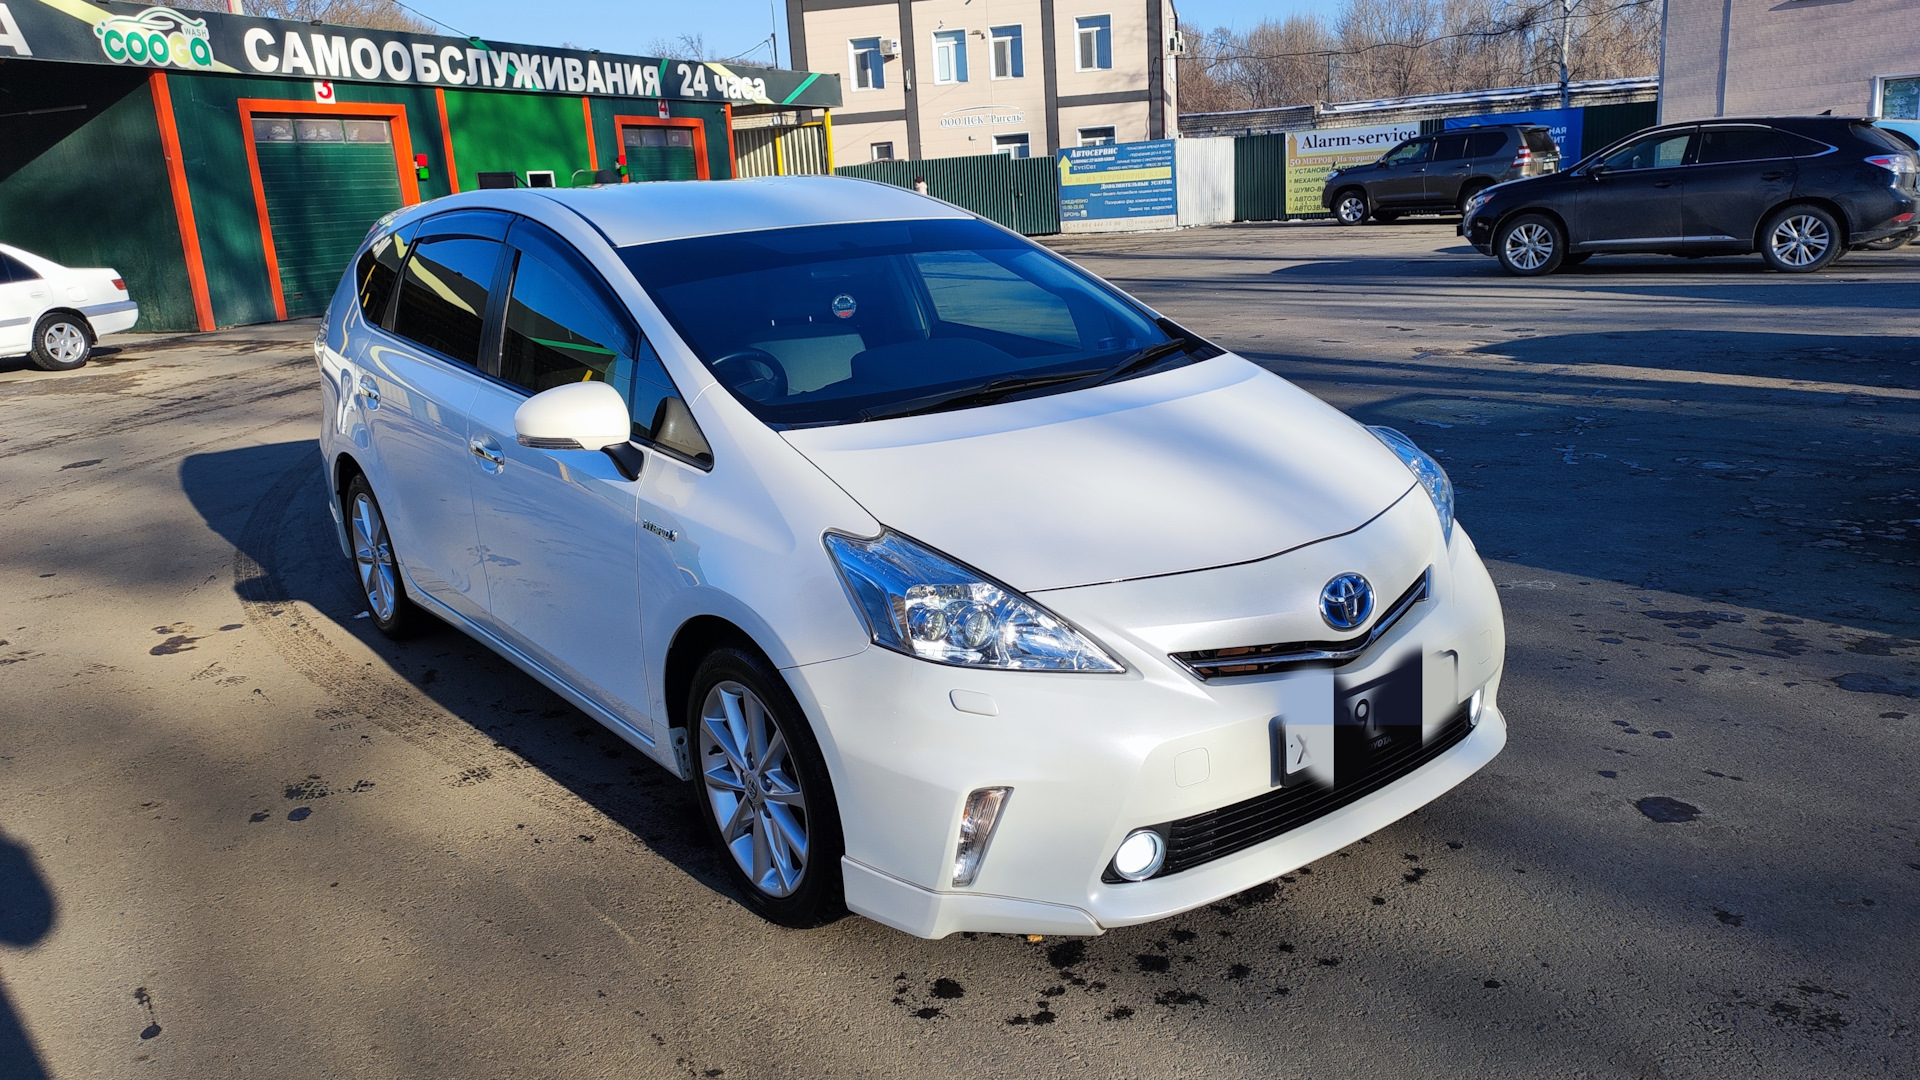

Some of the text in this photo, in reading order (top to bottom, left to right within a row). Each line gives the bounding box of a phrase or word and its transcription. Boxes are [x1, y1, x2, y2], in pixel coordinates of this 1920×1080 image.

[184, 27, 207, 37] WASH
[243, 27, 767, 100] САМООБСЛУЖИВАНИЯ 24 часа
[317, 79, 333, 99] 3
[658, 98, 668, 115] 4
[940, 117, 961, 127] ООО
[963, 115, 984, 126] ПСК
[1548, 126, 1567, 135] НАЯ
[1301, 128, 1417, 149] Alarm-service
[1289, 158, 1301, 167] 50
[1302, 156, 1333, 165] МЕТРОВ
